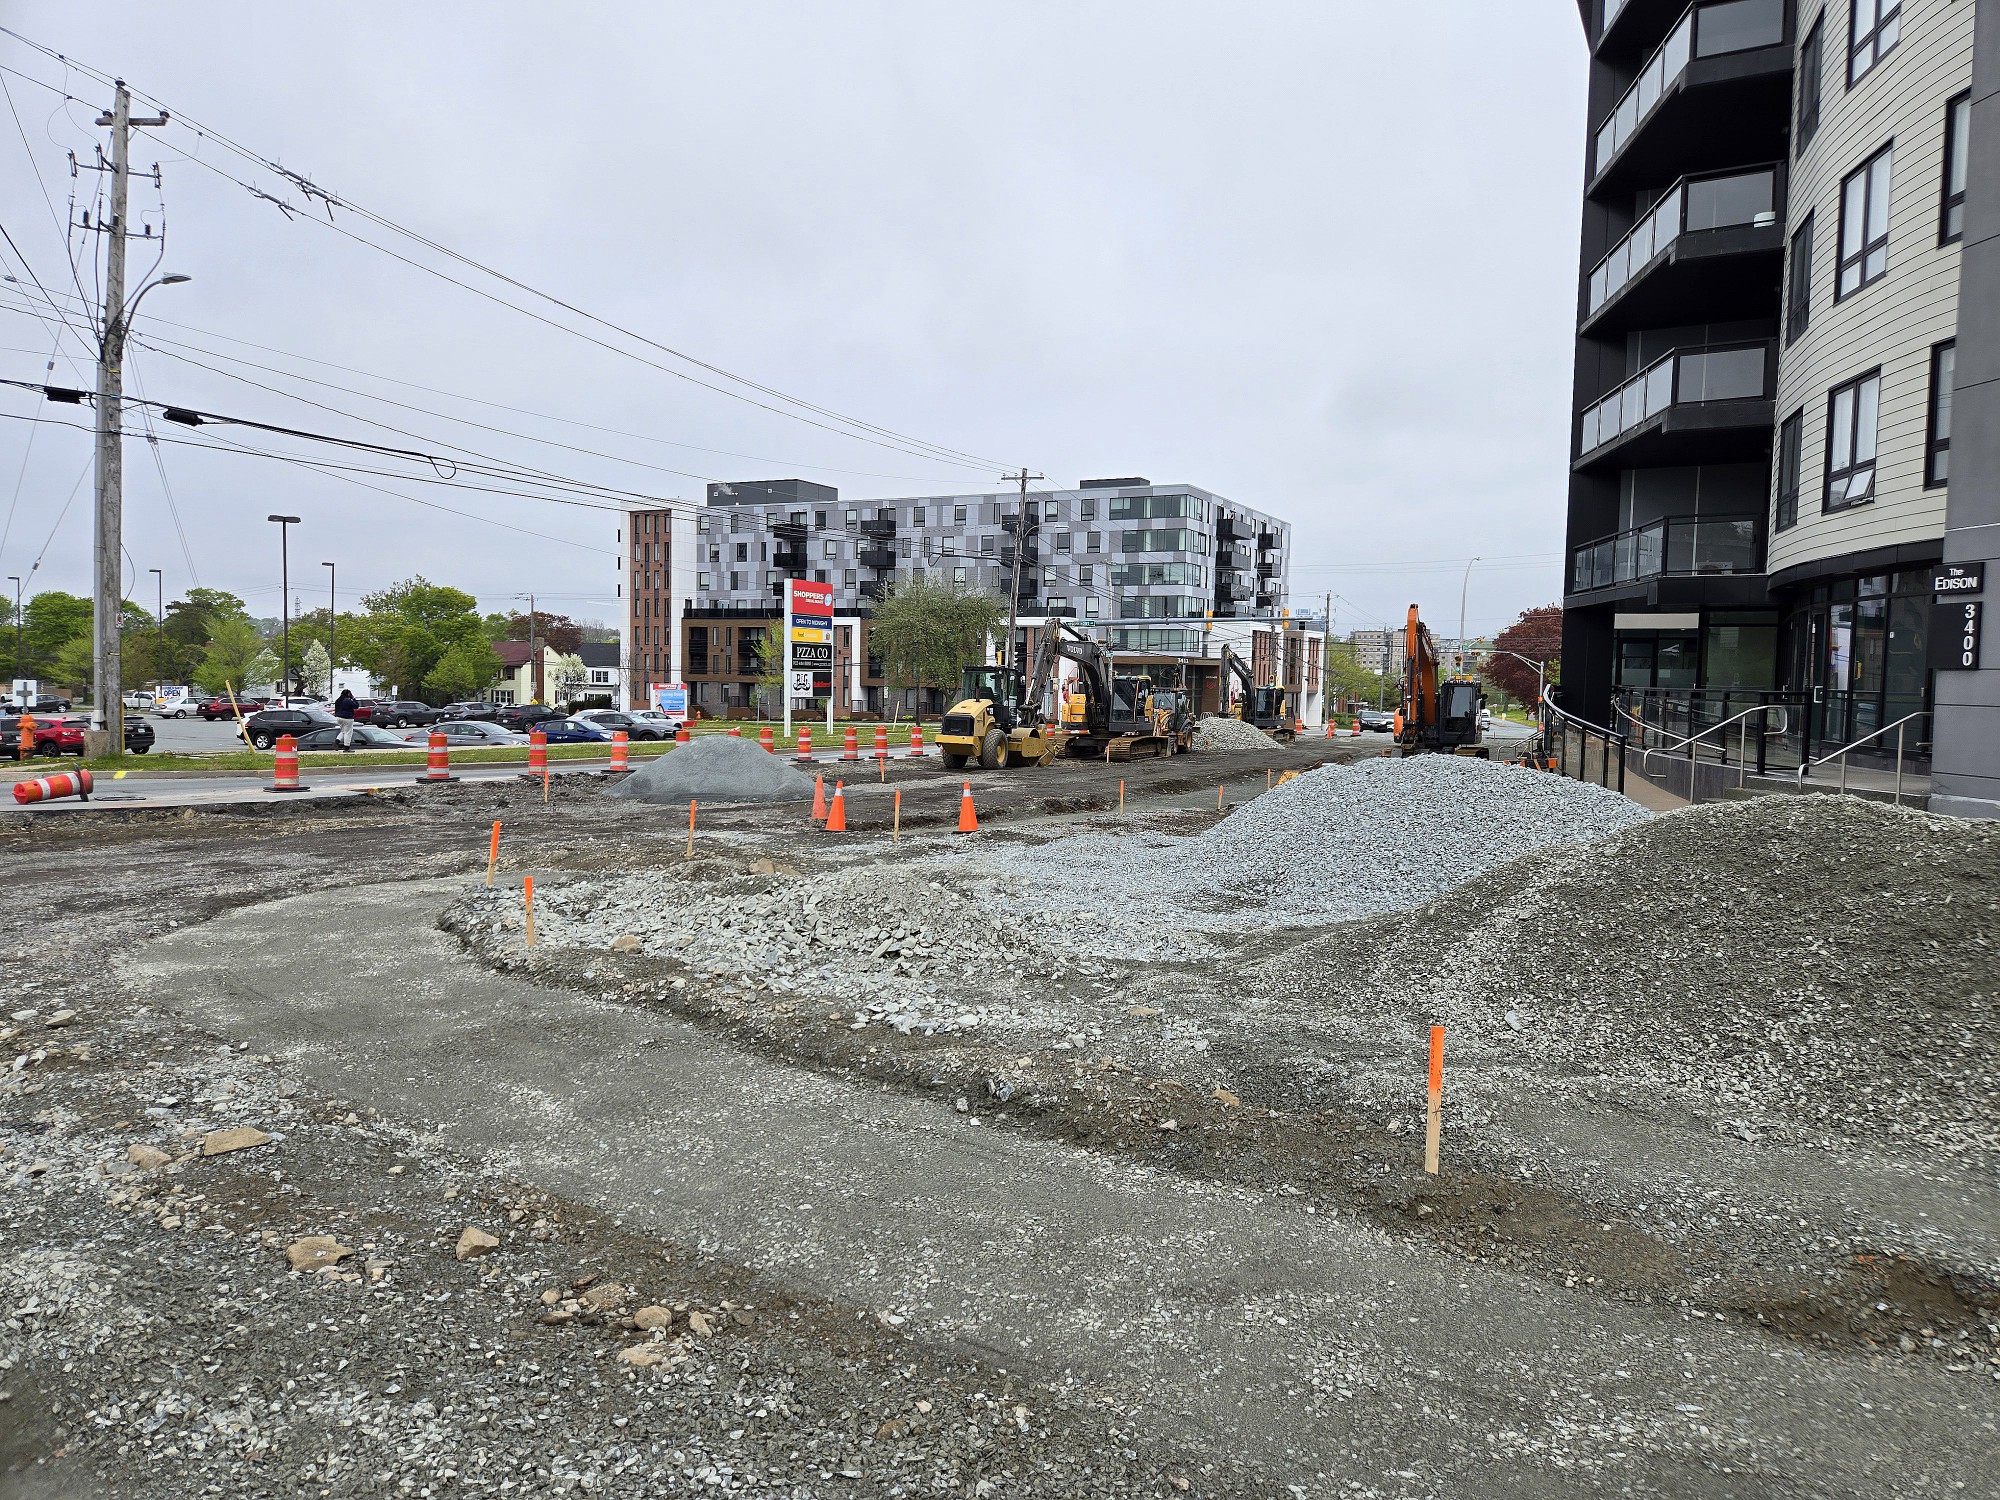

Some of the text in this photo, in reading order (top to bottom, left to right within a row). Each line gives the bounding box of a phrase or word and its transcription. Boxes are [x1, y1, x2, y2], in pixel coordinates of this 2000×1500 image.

[1949, 568, 1965, 576] The
[1935, 577, 1978, 590] EDISON
[793, 590, 824, 600] SHOPPERS
[1962, 604, 1976, 666] 3400
[817, 647, 828, 658] CO
[163, 689, 181, 697] OPEN
